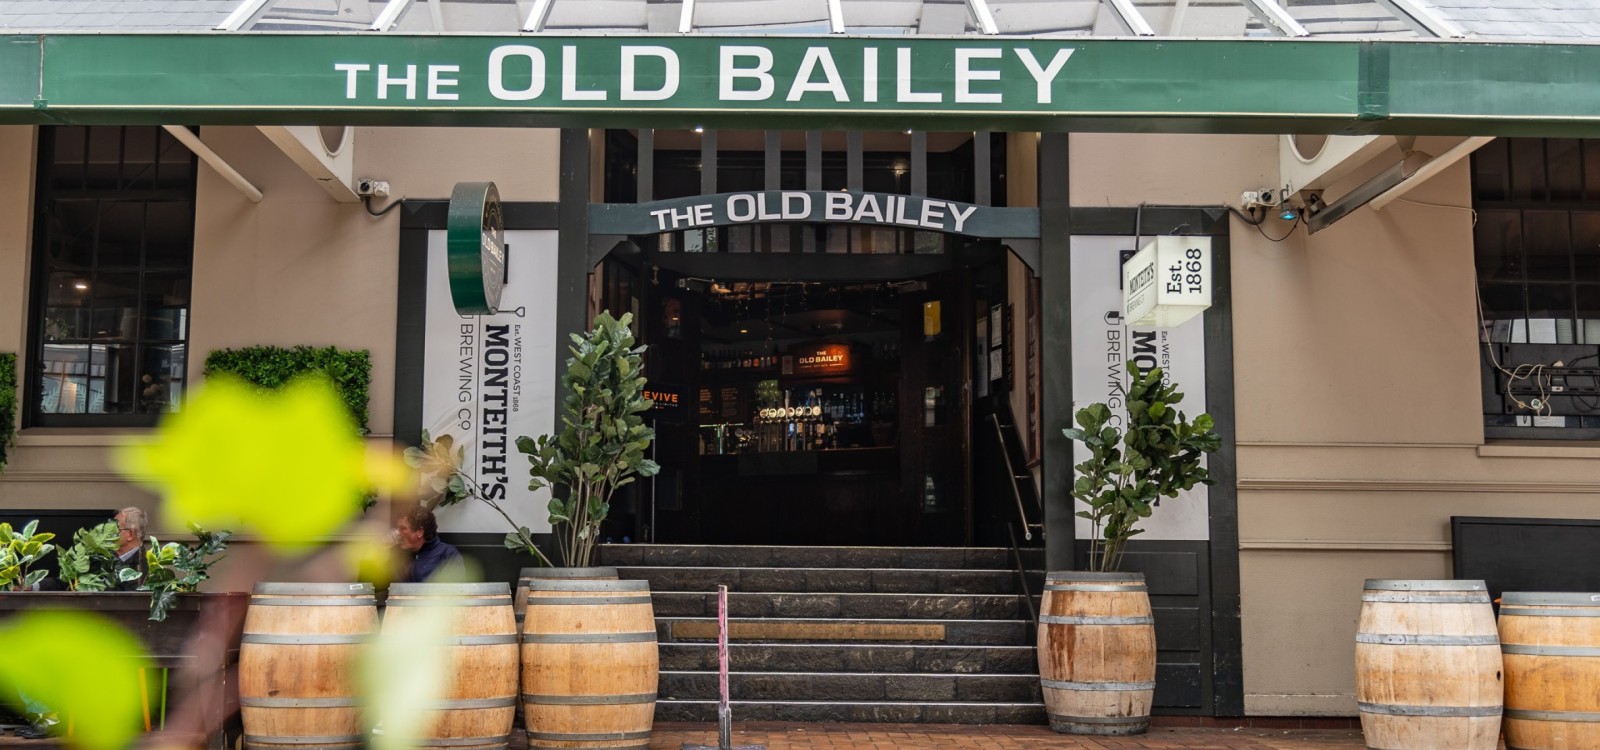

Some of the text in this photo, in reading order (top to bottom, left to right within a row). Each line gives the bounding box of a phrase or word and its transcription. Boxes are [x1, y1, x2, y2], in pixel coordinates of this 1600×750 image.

[334, 44, 1077, 104] THE OLD BAILEY
[650, 191, 978, 232] THE OLD BAILEY
[1166, 260, 1182, 295] Est.
[1185, 248, 1203, 295] 1868
[458, 324, 474, 403] BREWING
[514, 337, 522, 364] WEST
[799, 354, 843, 364] OLD BAILEY
[1161, 343, 1170, 371] WEST
[513, 365, 521, 396] COAST
[1107, 330, 1121, 410] BREWING
[481, 324, 510, 501] MONTEITH'S
[641, 390, 679, 403] EVIVE
